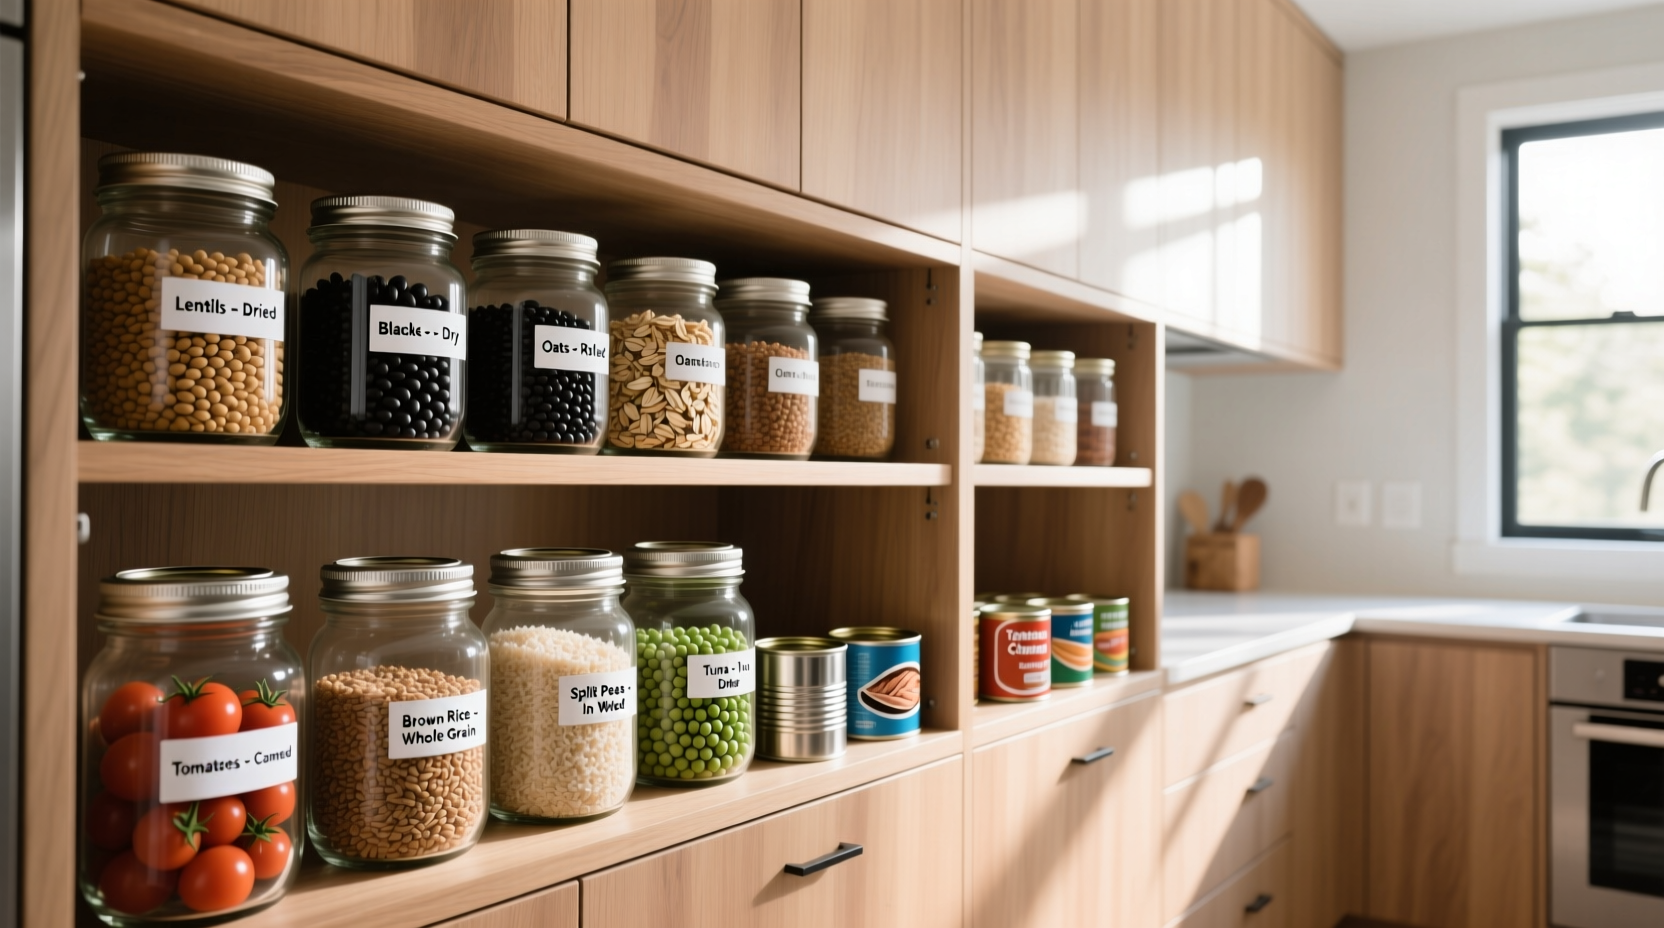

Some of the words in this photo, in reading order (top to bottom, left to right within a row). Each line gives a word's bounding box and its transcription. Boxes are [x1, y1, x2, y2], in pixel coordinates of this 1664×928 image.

[243, 302, 276, 320] Dried
[442, 326, 460, 347] Dry
[542, 340, 570, 353] Oats
[703, 664, 729, 676] Tuna
[402, 714, 444, 728] Brown
[447, 709, 471, 722] Rice
[402, 728, 444, 746] Whole
[447, 724, 476, 740] Grain
